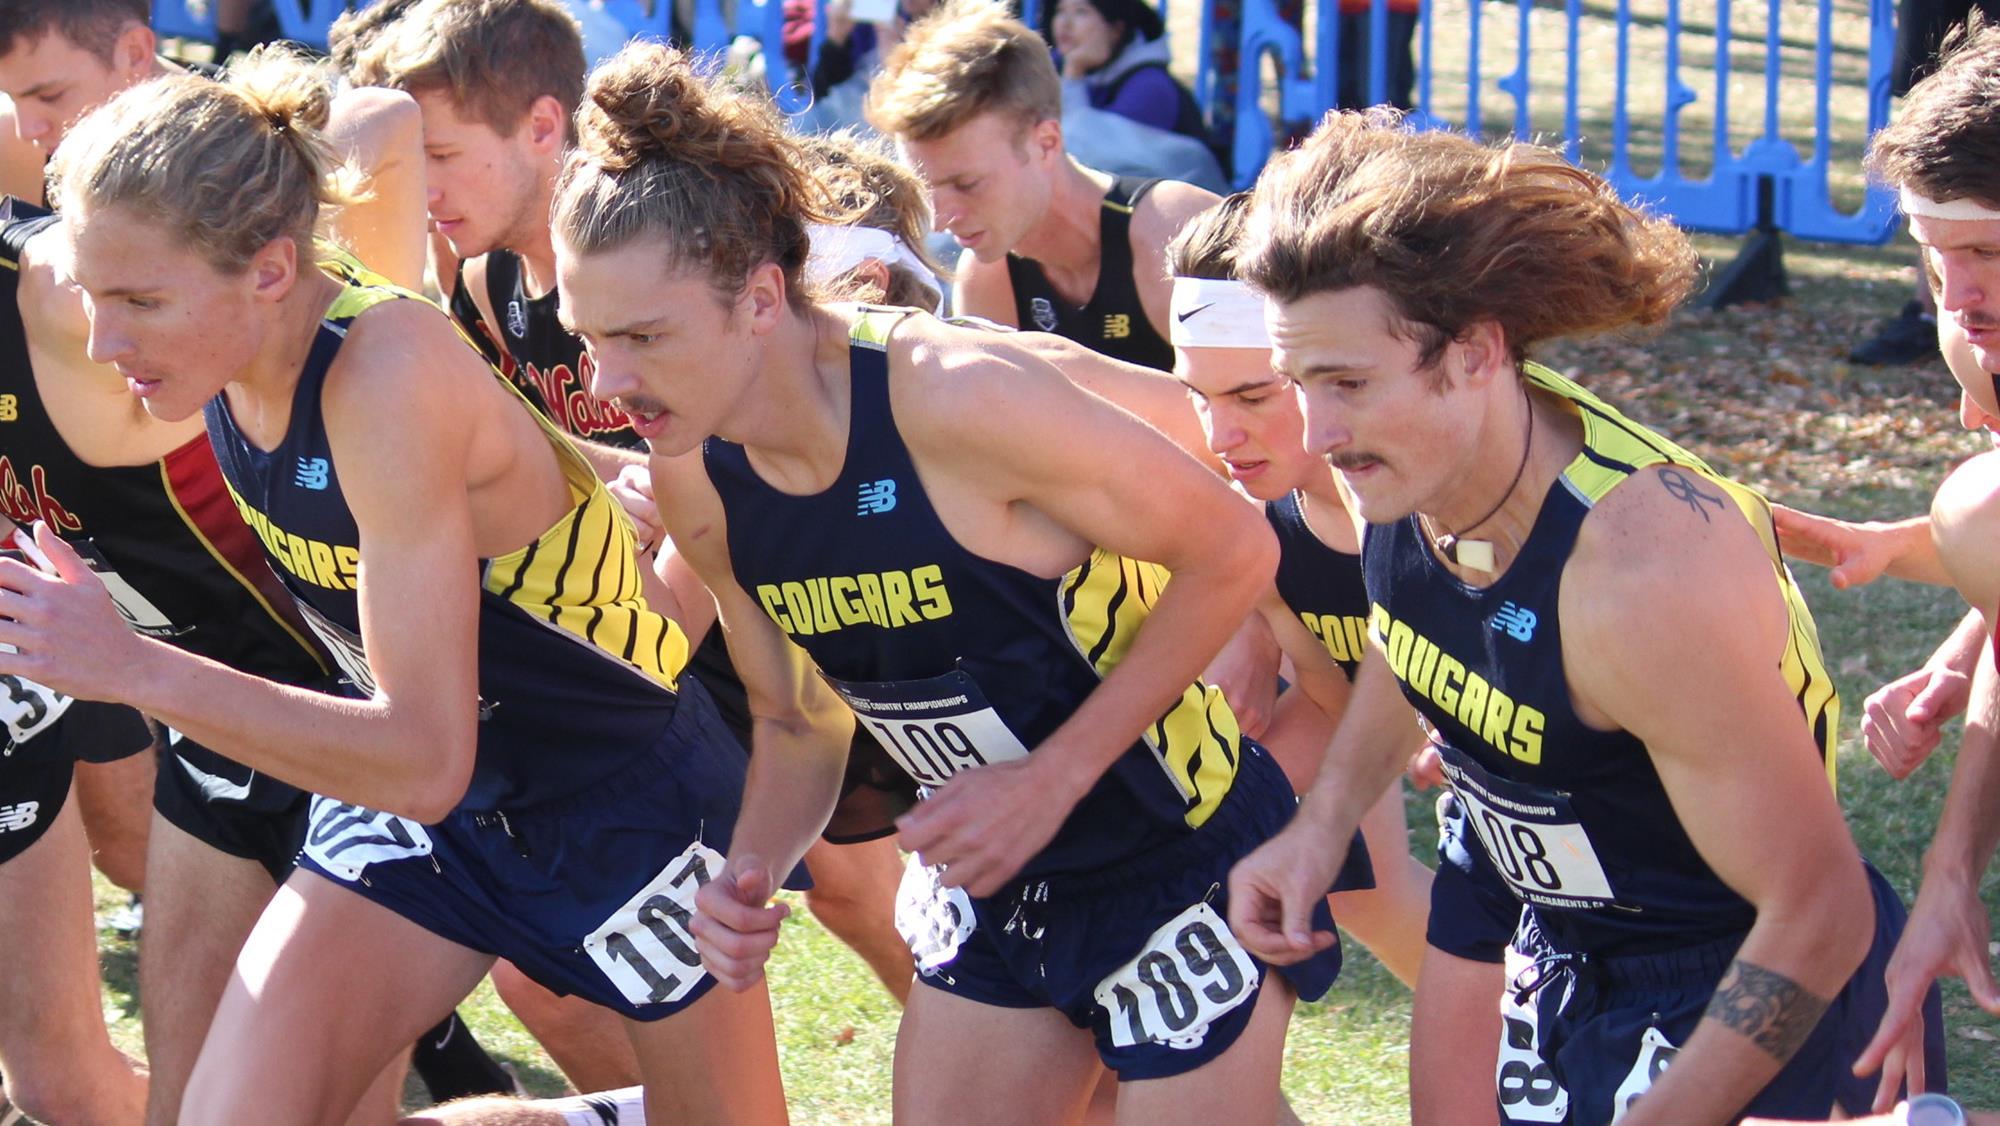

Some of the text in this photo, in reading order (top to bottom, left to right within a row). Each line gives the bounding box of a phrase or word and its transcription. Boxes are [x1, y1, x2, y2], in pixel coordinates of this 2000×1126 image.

[756, 564, 953, 635] COUGARS
[903, 694, 969, 711] CHAMPIONSHIPS
[1369, 601, 1546, 766] COUGARS
[871, 721, 988, 781] 109
[1110, 920, 1245, 1045] 109
